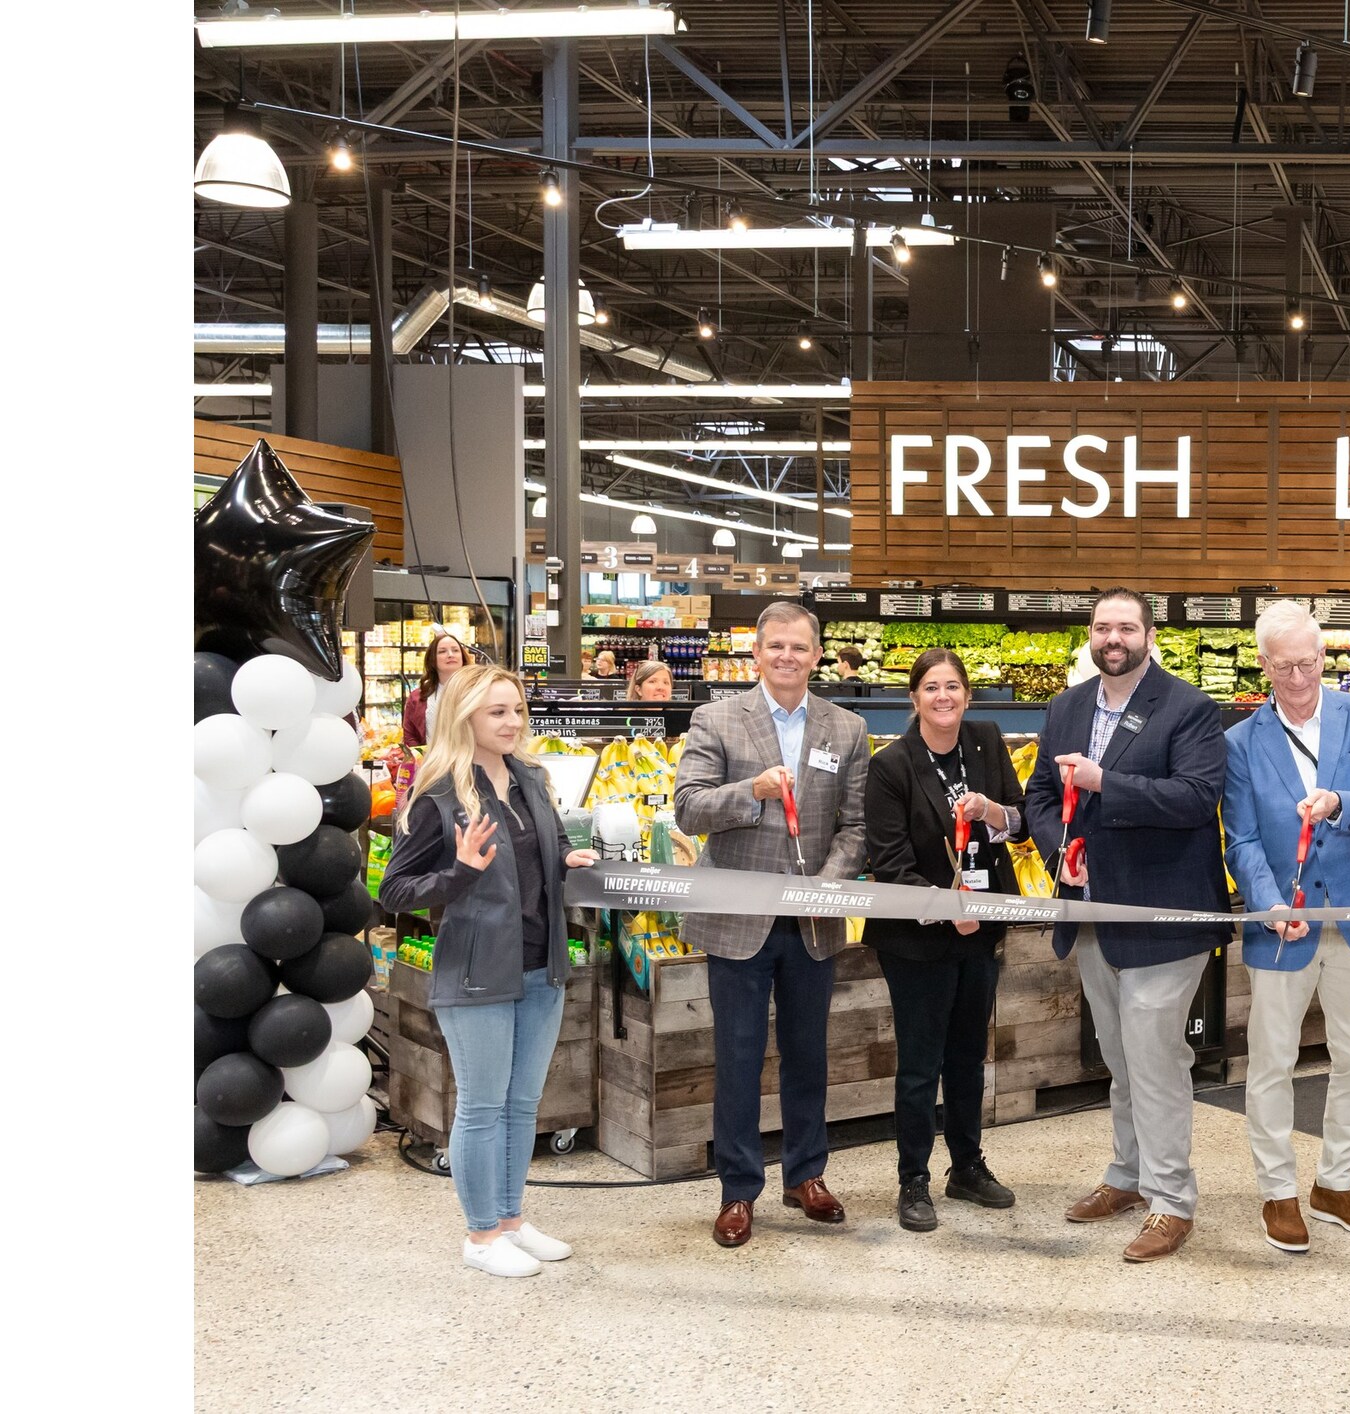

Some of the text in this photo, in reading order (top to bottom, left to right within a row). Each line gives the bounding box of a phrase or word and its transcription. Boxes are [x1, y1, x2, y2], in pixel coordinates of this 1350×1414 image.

[890, 434, 1192, 519] FRESH
[604, 546, 618, 569] 3
[685, 557, 699, 579] 4
[755, 568, 767, 587] 5
[524, 646, 548, 655] SAVE
[524, 654, 547, 663] BIG!
[528, 717, 563, 727] Organic
[565, 717, 601, 726] Bananas
[640, 866, 662, 875] meijer
[604, 877, 691, 895] INDEPENDENCE
[821, 881, 843, 890] meijer
[627, 896, 661, 906] MARKET
[782, 890, 873, 907] INDEPENDENCE
[1005, 898, 1027, 906] meijer
[804, 906, 841, 915] MARKET
[965, 904, 1058, 918] INDEPENDENCE
[1188, 1018, 1204, 1035] LB
